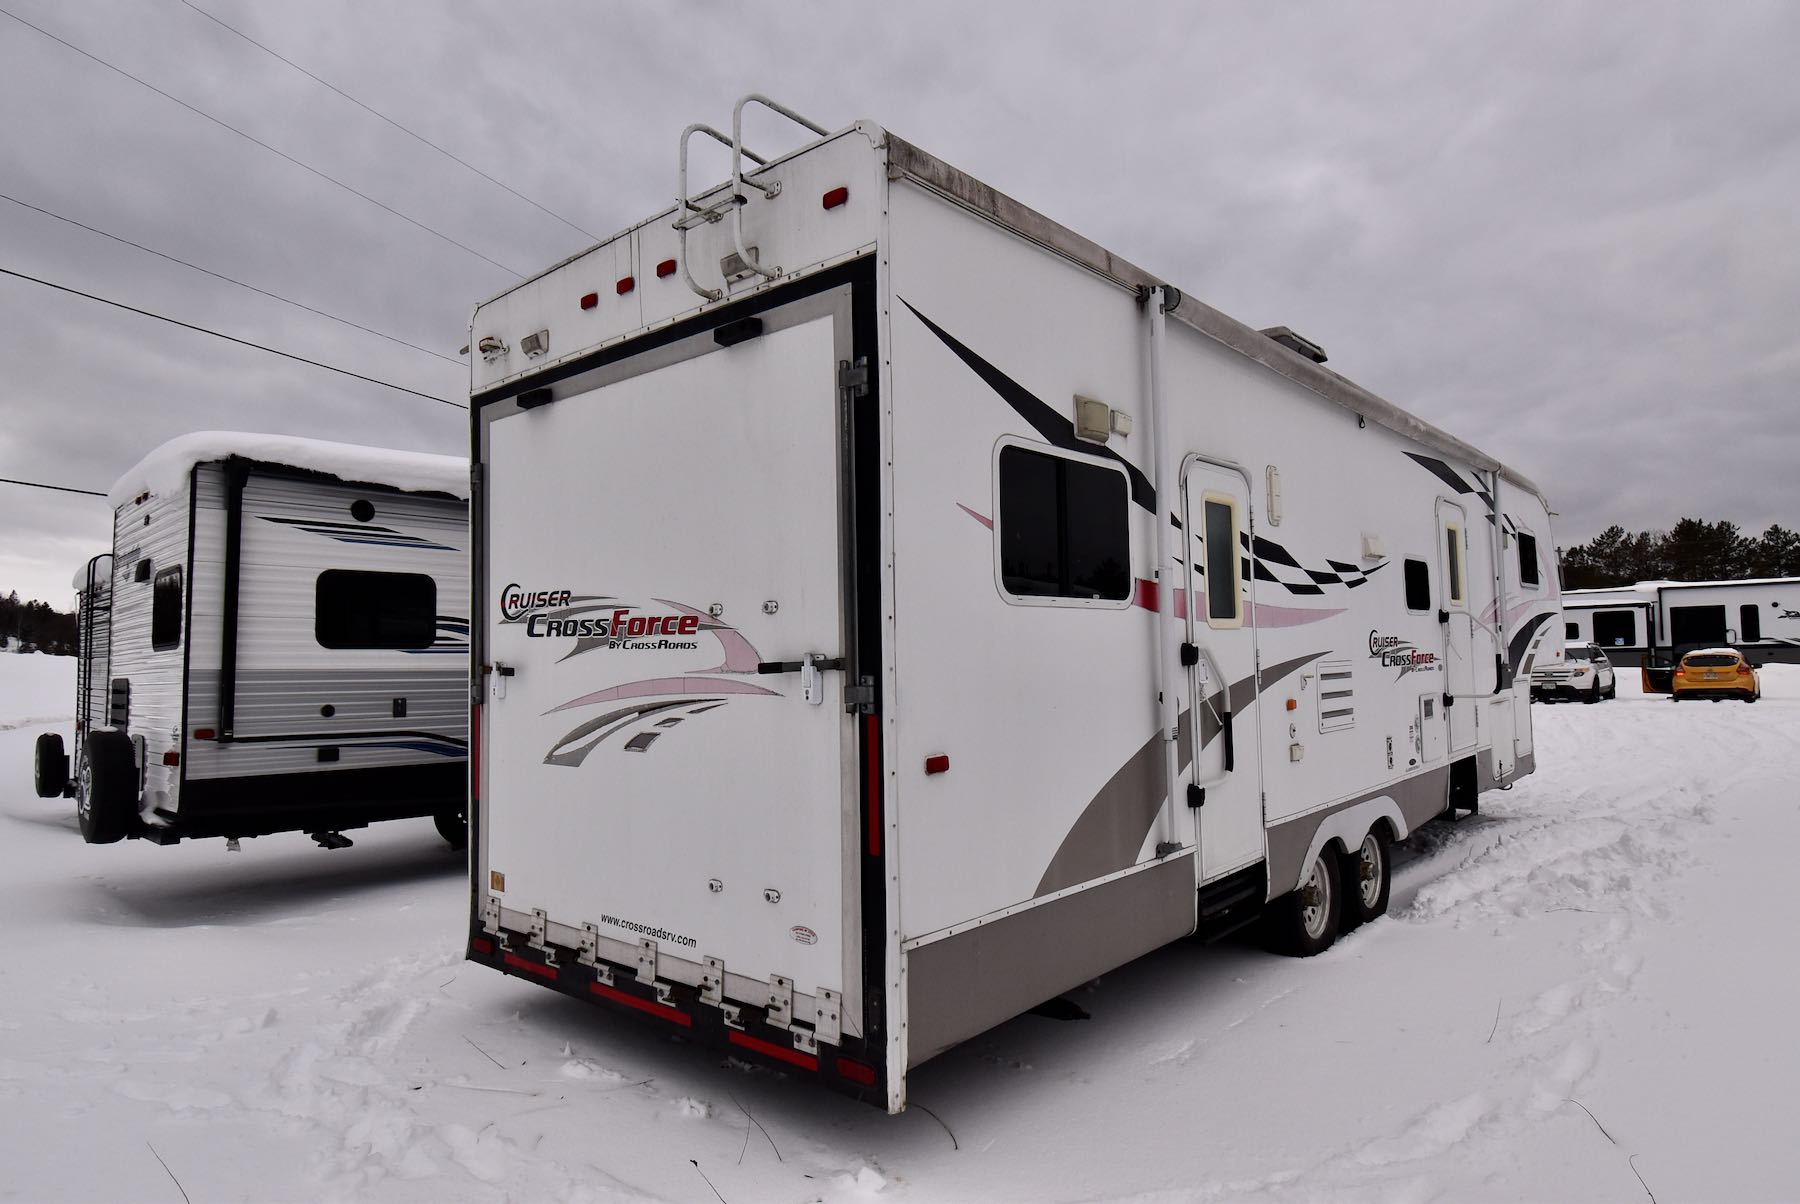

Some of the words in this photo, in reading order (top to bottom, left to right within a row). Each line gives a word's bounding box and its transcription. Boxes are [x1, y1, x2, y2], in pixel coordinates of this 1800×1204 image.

[500, 583, 571, 621] CRUISER
[1369, 629, 1398, 656] CRUISER
[600, 913, 697, 948] www.crossroadsrv.com
